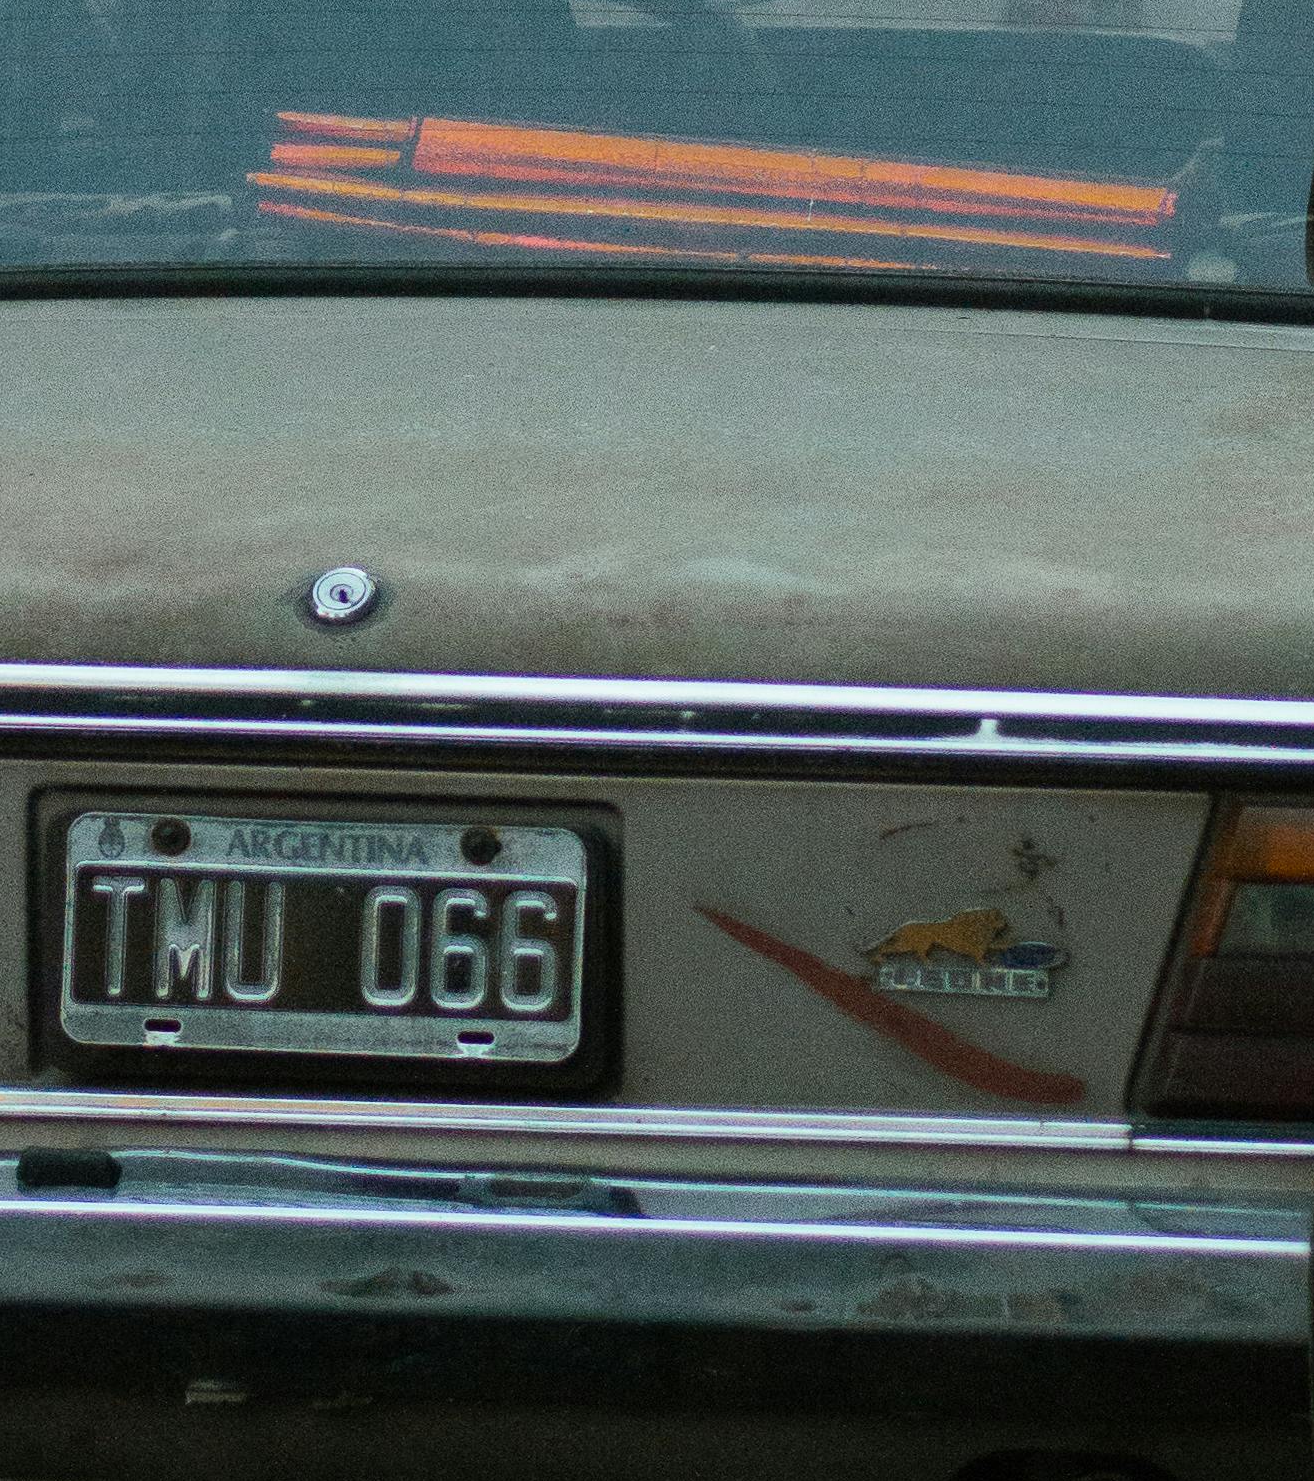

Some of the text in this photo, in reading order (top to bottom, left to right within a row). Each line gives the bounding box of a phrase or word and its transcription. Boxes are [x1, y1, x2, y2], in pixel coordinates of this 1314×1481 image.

[225, 827, 430, 866] ARGENTINA
[91, 875, 561, 1013] TMU 066
